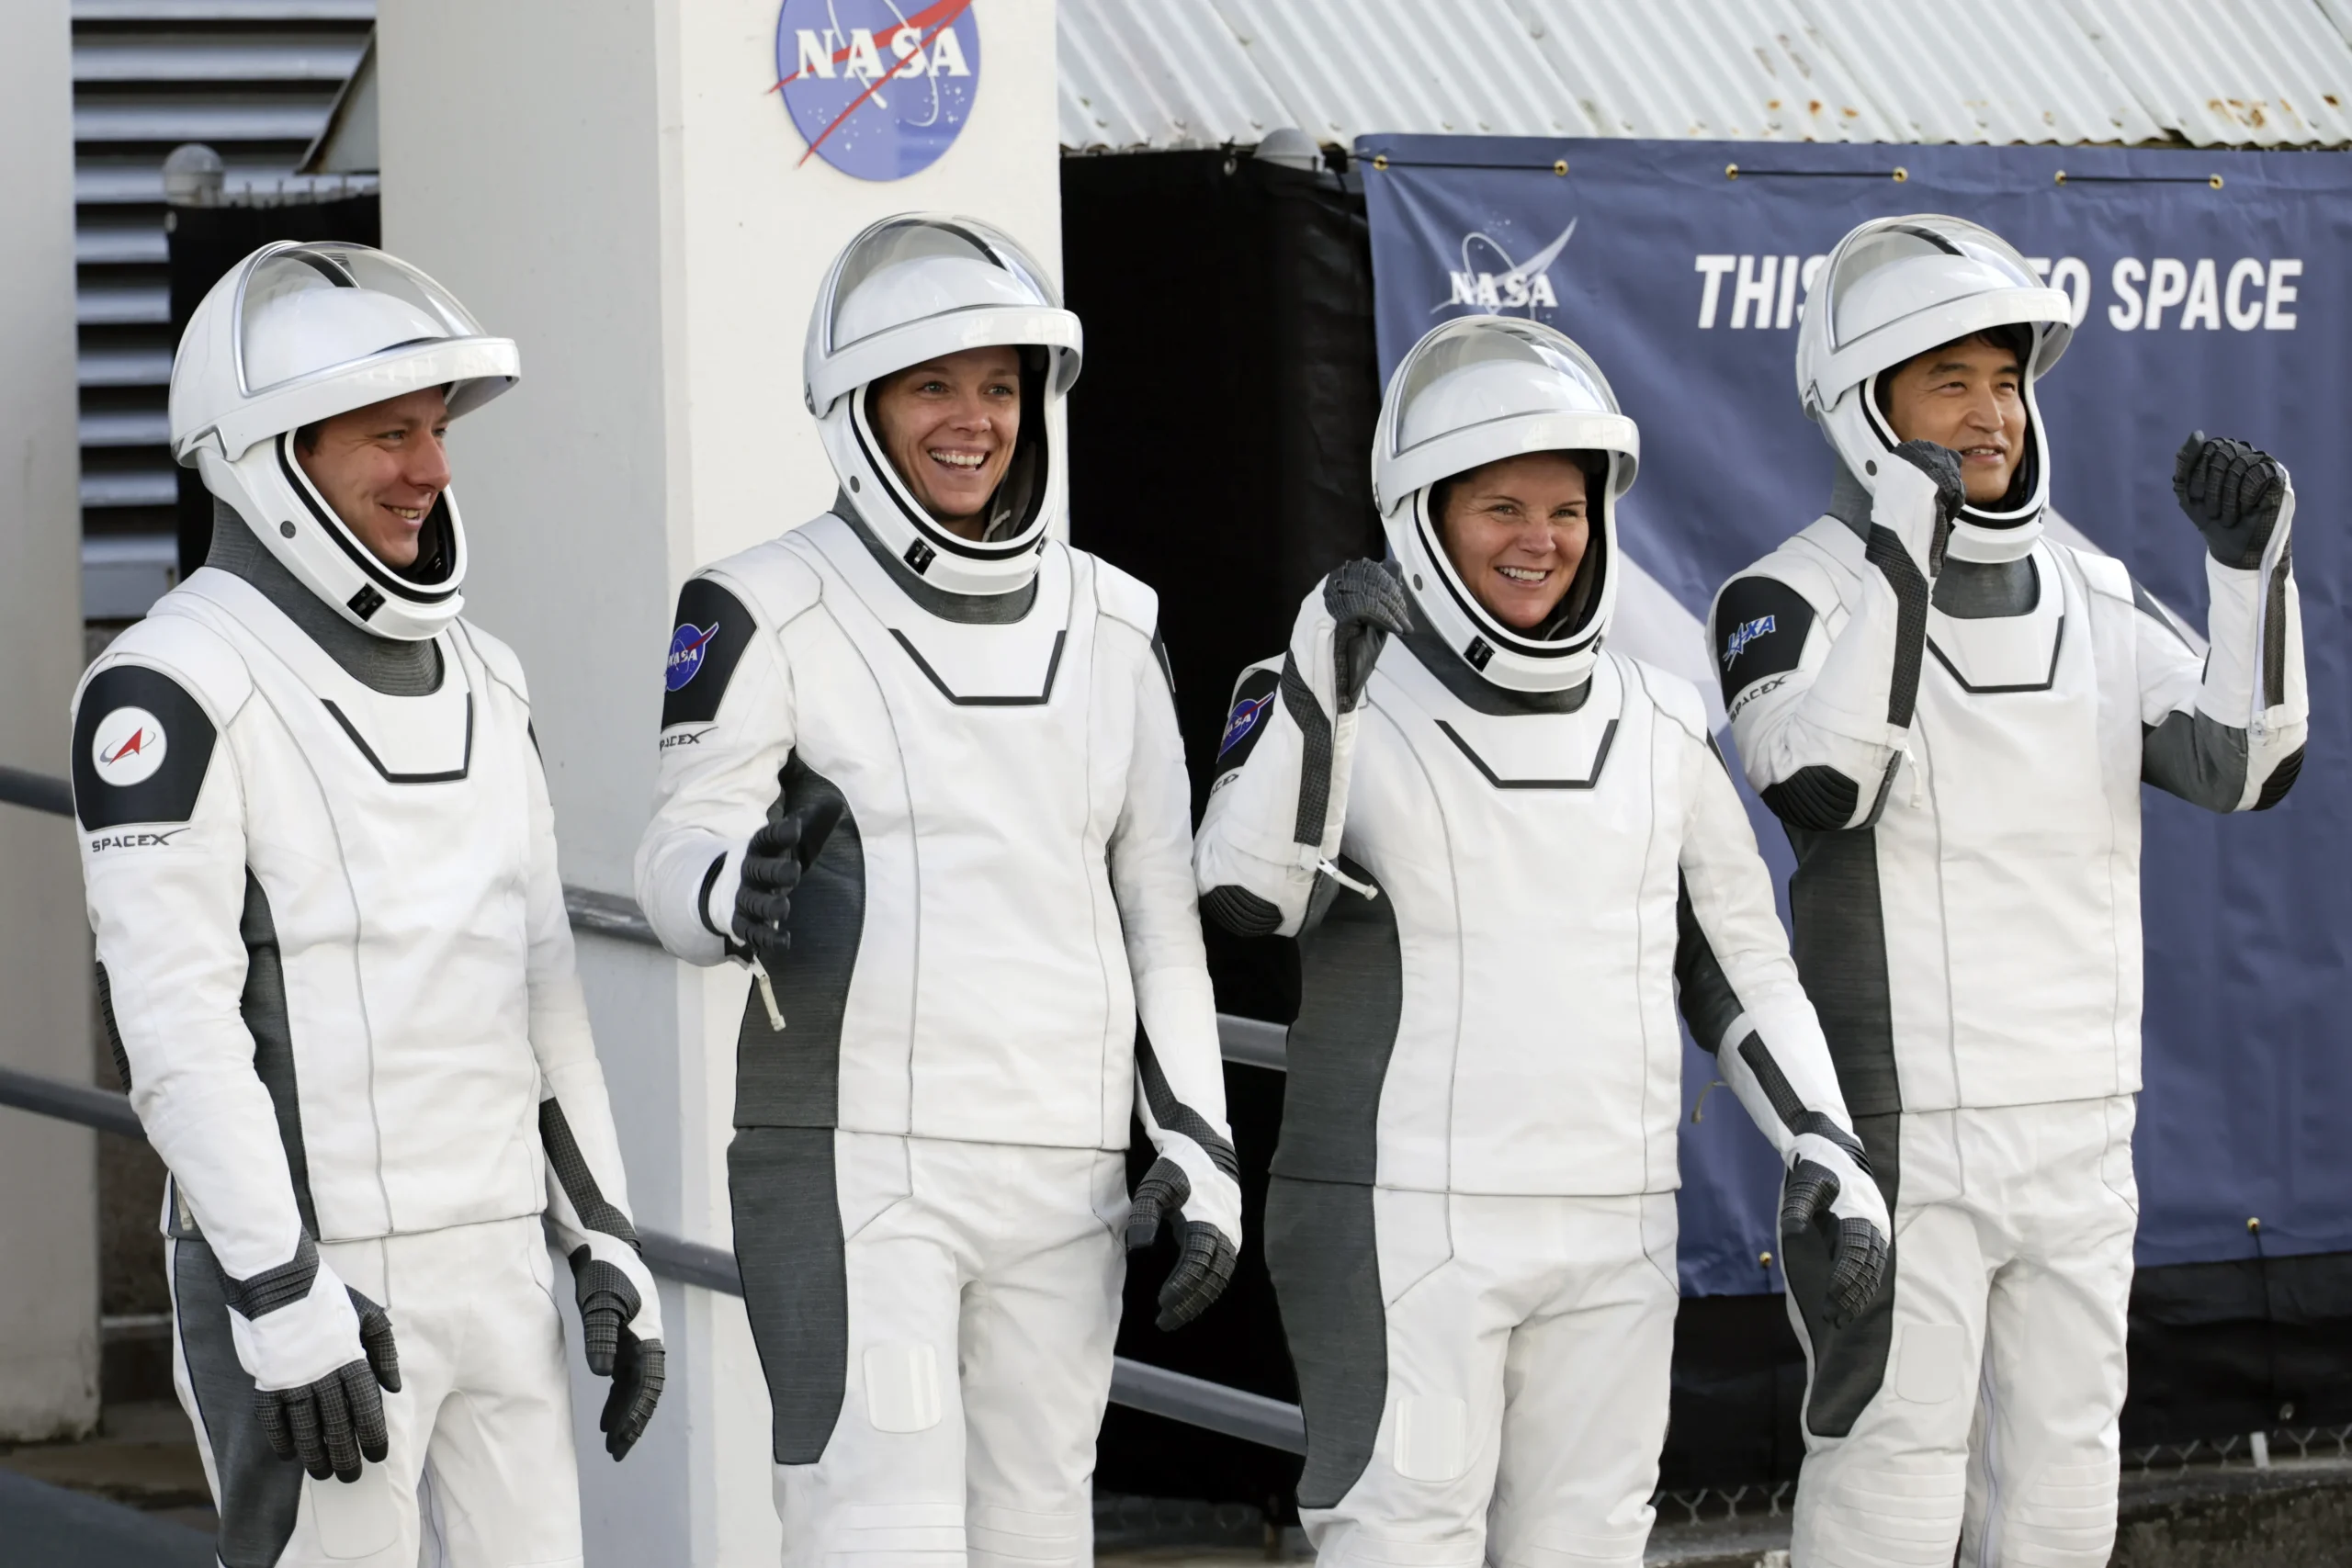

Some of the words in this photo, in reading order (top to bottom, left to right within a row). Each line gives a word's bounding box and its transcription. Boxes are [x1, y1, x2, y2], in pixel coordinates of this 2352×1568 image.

[796, 28, 971, 79] NASA
[1450, 271, 1559, 308] NASA
[2024, 255, 2091, 330] O
[2108, 256, 2303, 332] SPACE
[1724, 615, 1776, 660] JAXA
[1729, 670, 1804, 724] SPACEX
[92, 828, 191, 852] SPACEX
